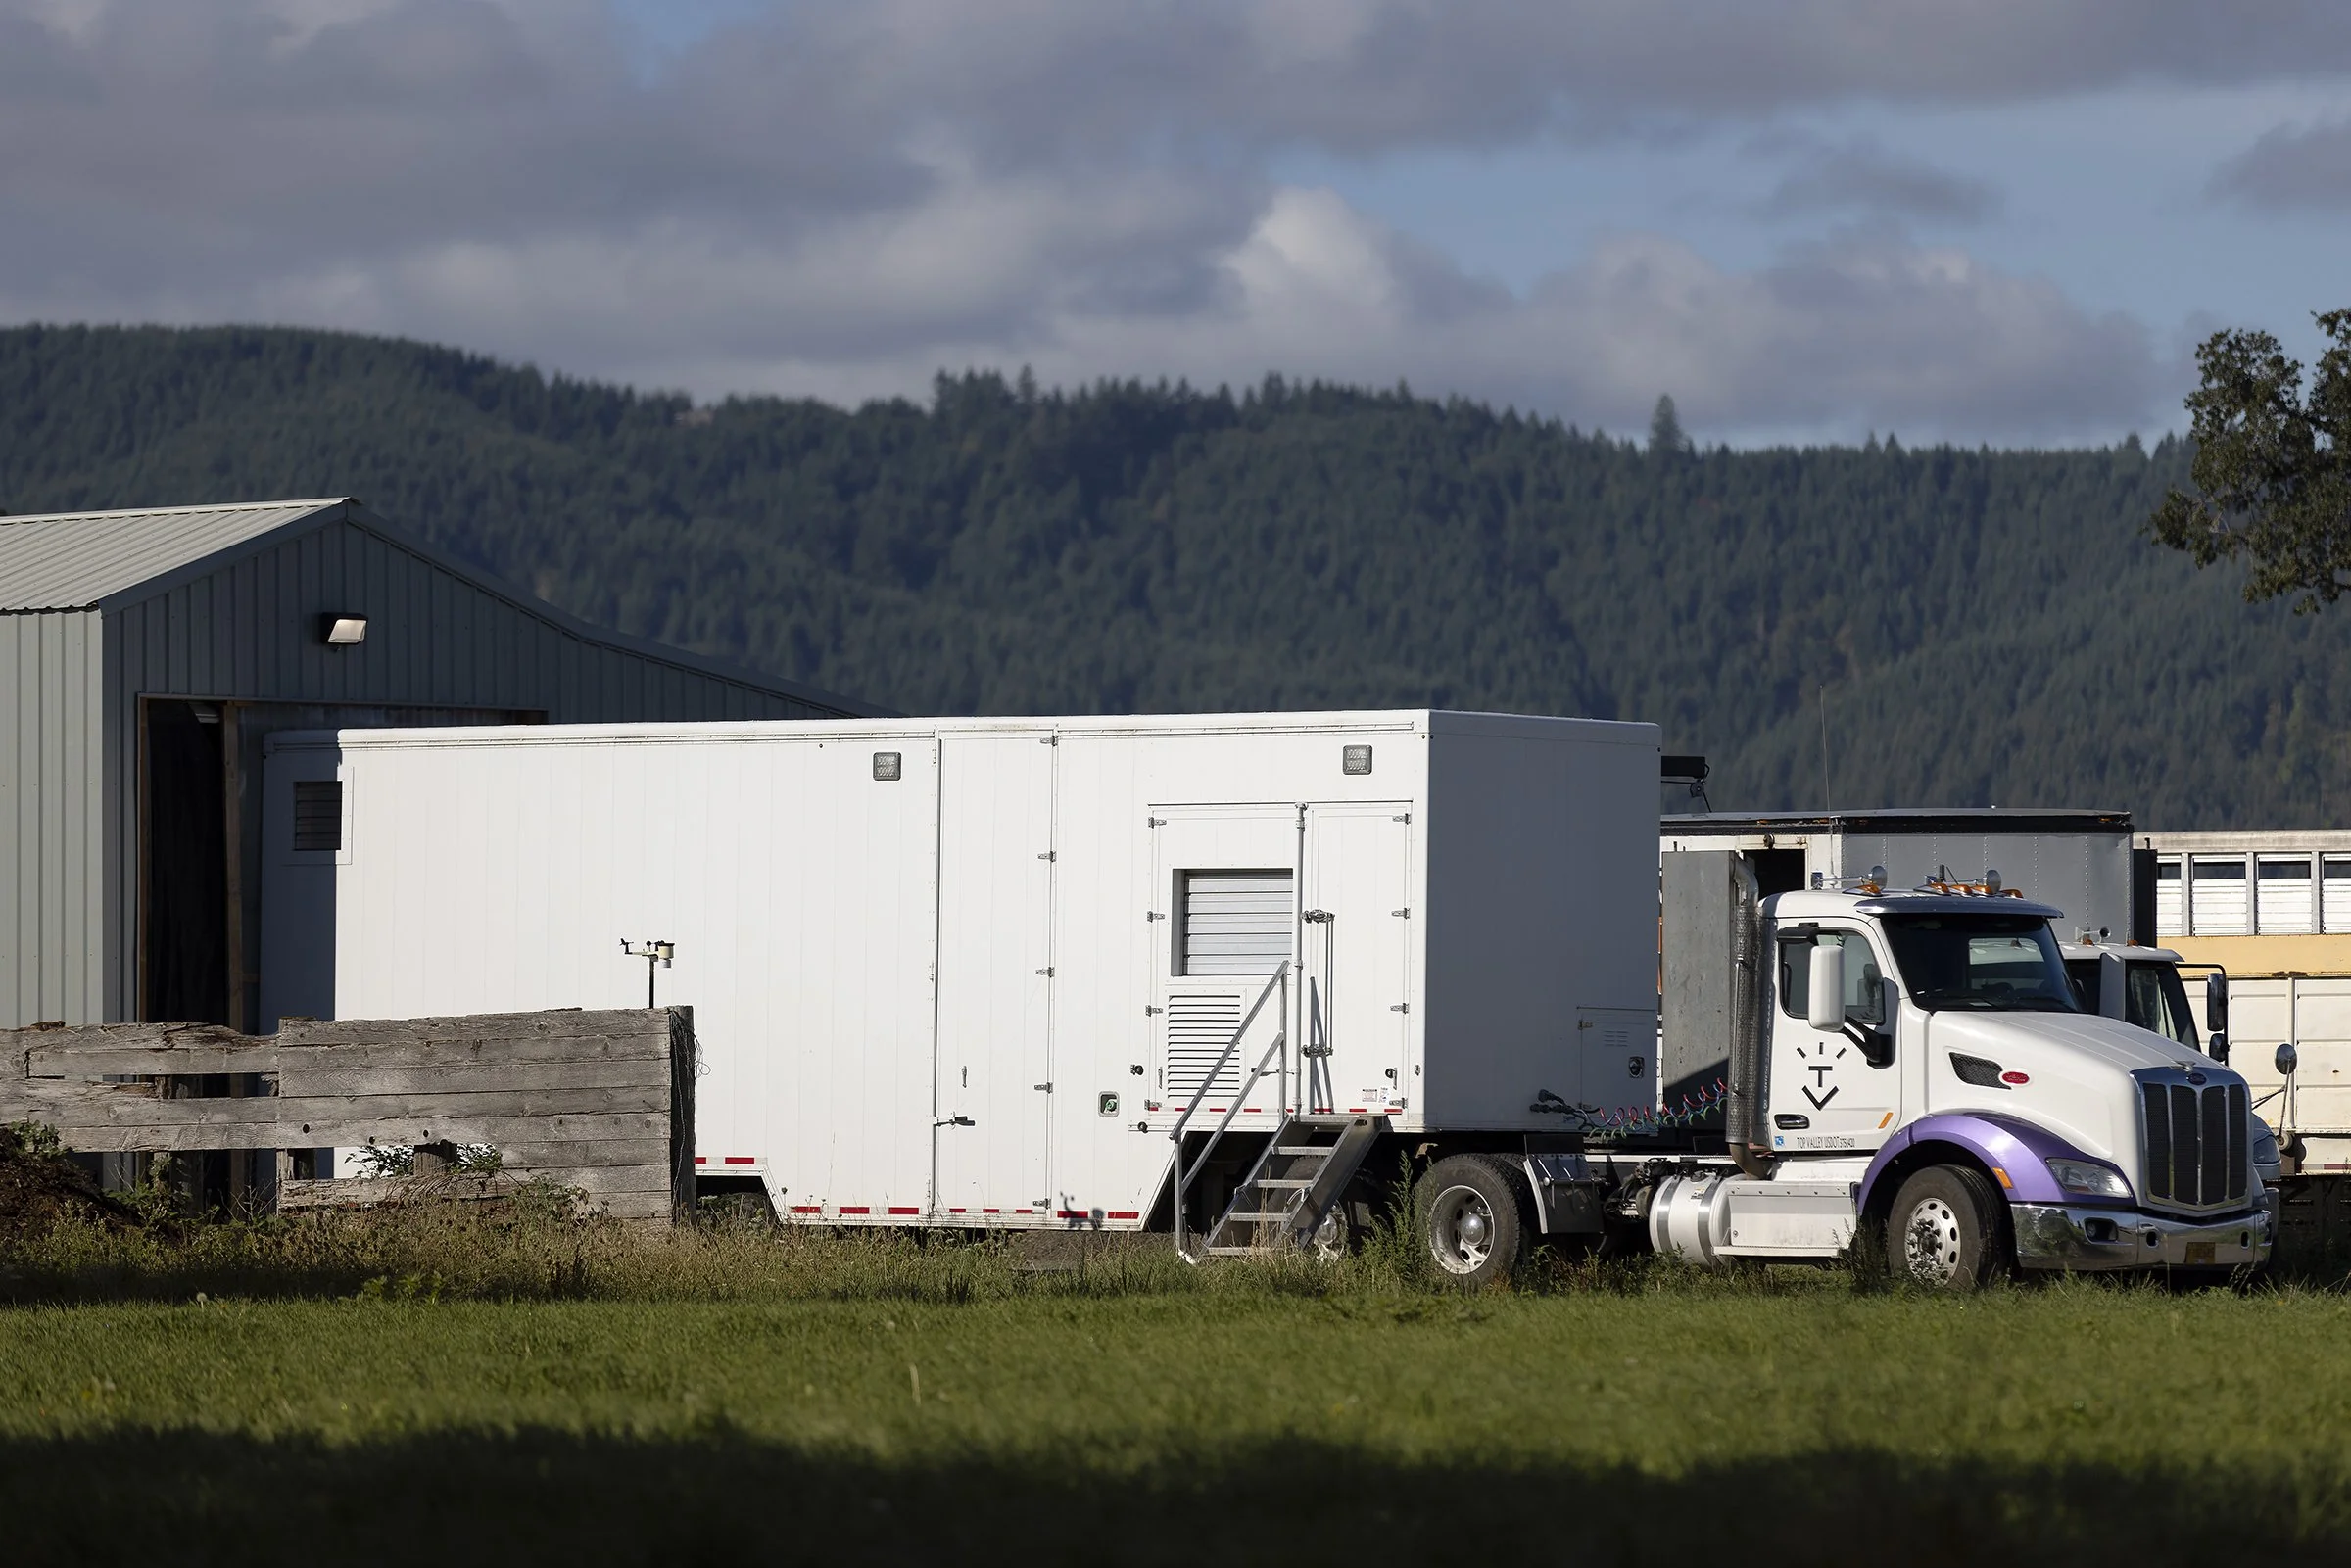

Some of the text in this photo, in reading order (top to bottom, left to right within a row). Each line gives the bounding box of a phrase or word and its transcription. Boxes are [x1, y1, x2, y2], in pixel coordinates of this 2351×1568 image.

[1808, 1066, 1833, 1088] T
[1797, 1137, 1805, 1149] TOP
[1806, 1136, 1823, 1149] VALLEY
[1824, 1136, 1839, 1148] USDOT
